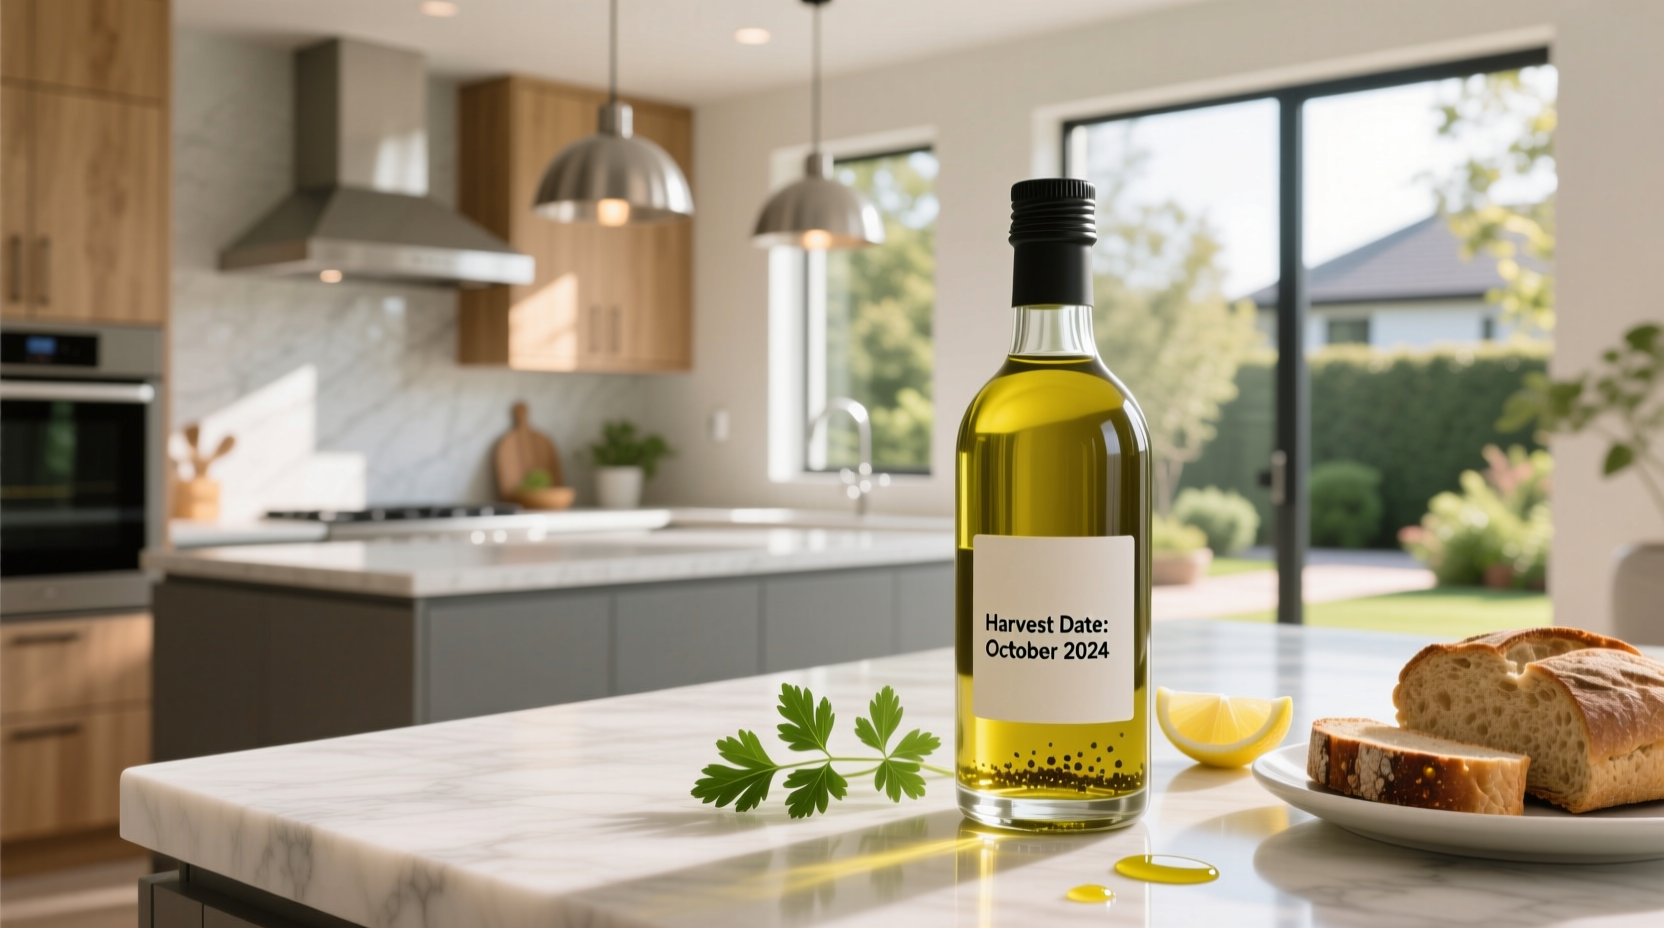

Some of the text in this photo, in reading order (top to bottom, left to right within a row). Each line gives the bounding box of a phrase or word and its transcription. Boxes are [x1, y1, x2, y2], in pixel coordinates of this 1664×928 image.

[986, 613, 1108, 633] Harvest Date:
[986, 639, 1109, 659] October 2024
